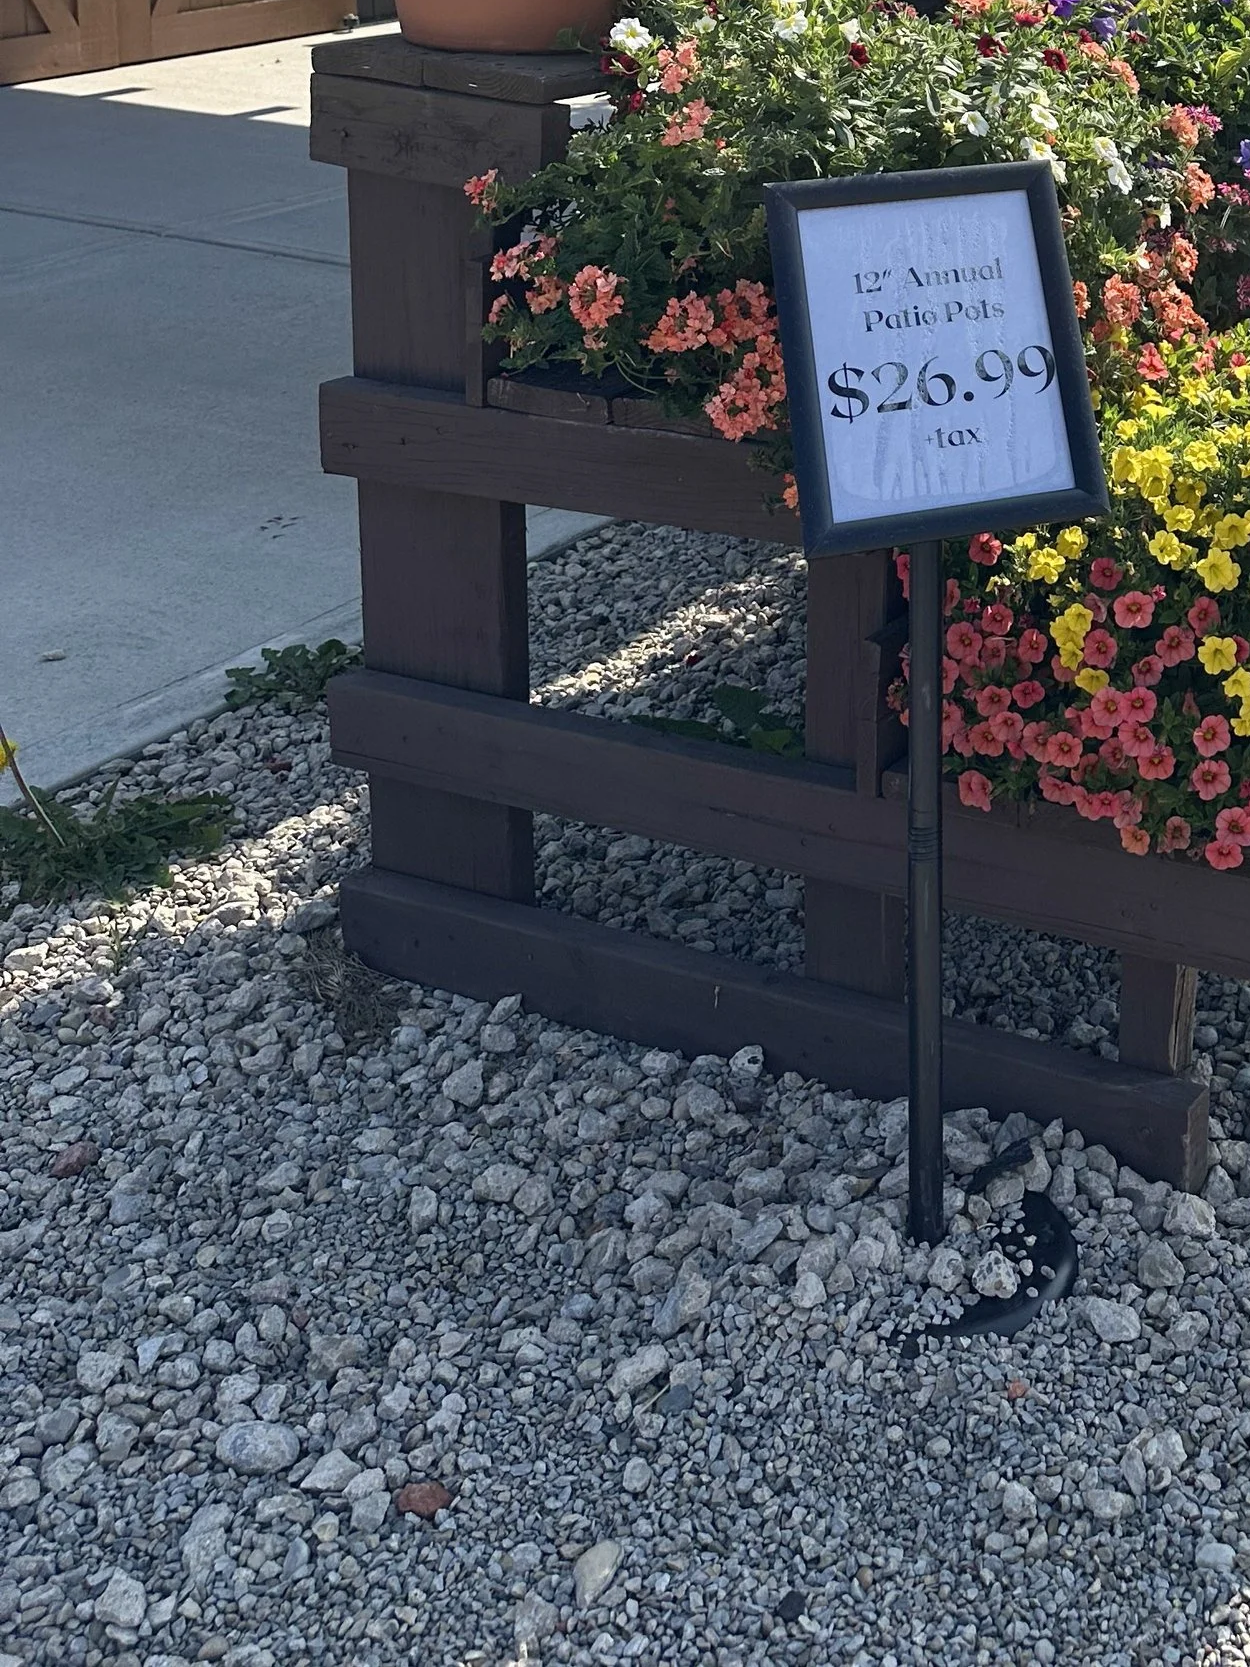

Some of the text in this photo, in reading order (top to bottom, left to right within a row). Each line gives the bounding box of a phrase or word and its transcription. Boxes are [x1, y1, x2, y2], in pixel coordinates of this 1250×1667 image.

[903, 257, 1003, 289] Annual
[864, 299, 1005, 332] Patio Pots
[827, 345, 1055, 424] $26.99
[925, 426, 982, 449] +tax
